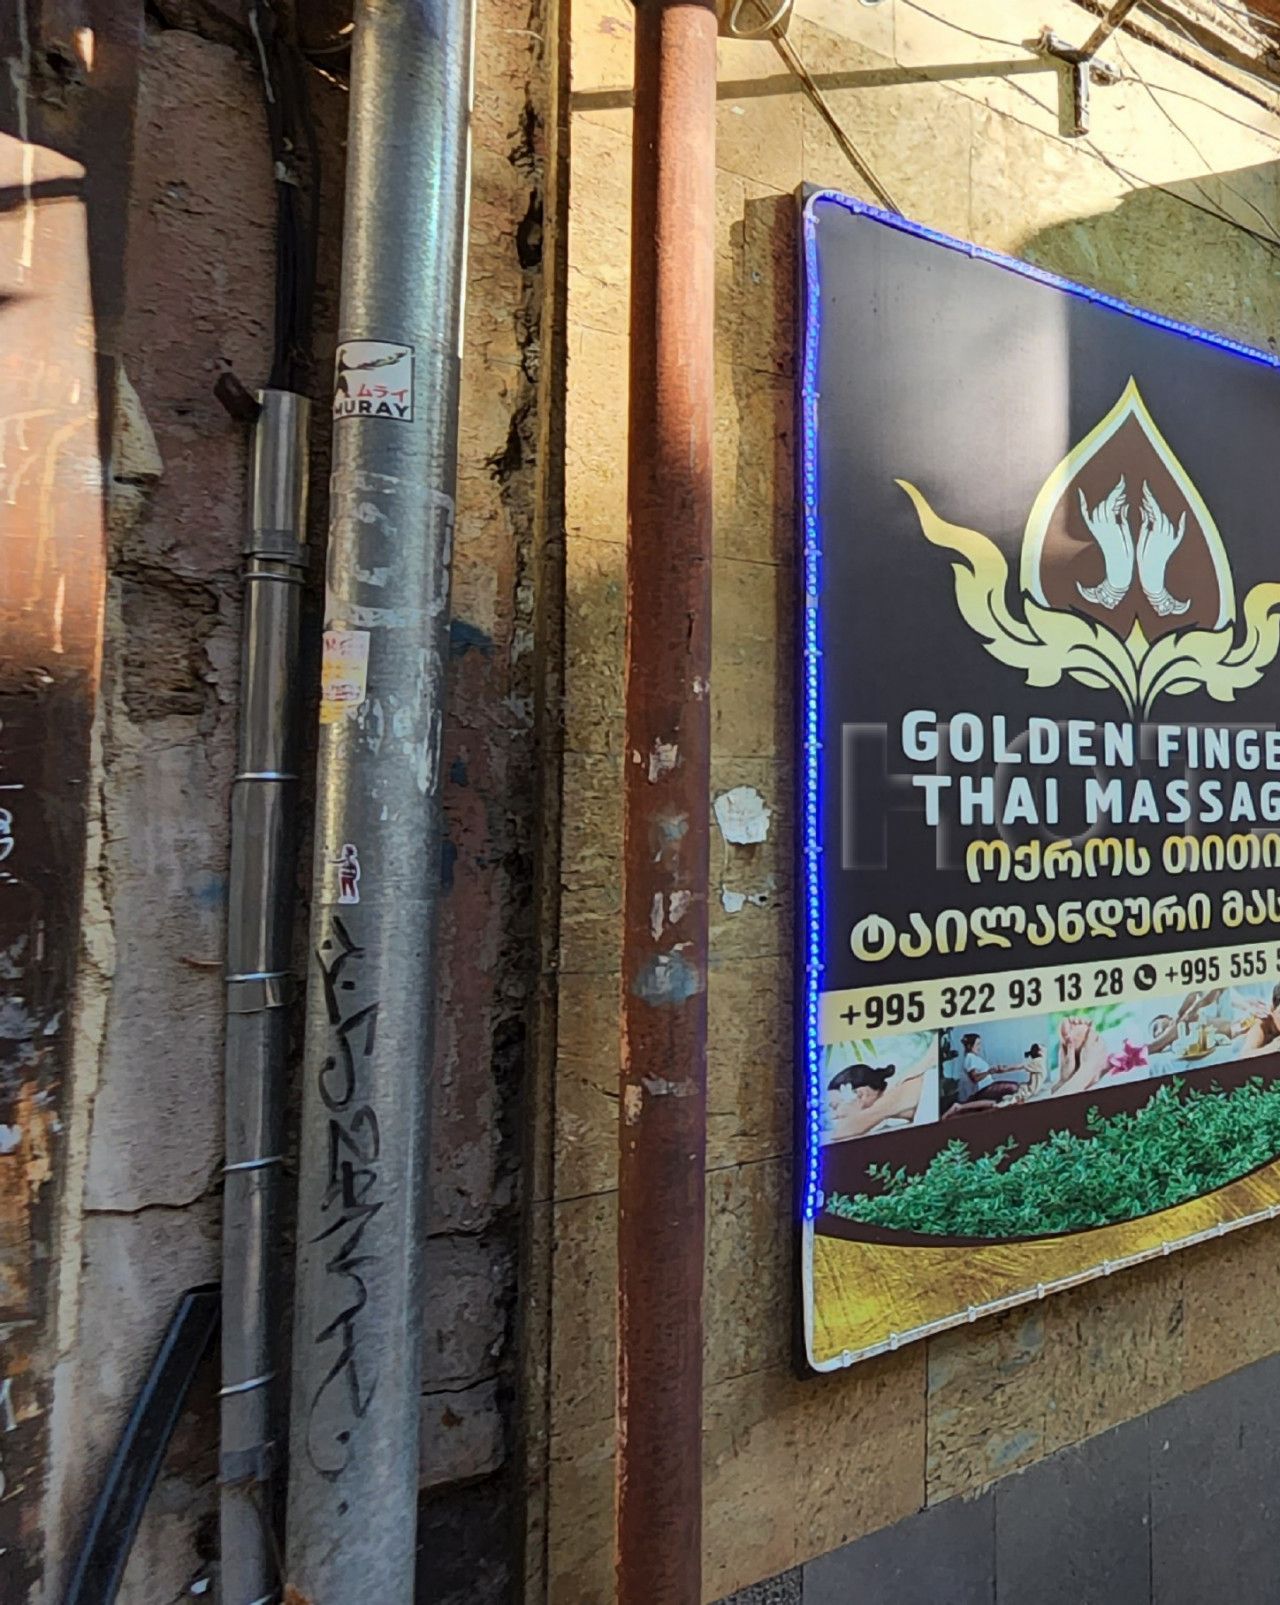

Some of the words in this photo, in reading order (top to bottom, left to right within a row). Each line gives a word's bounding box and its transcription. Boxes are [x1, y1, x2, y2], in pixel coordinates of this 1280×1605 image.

[901, 709, 1136, 768] GOLDEN
[912, 774, 1059, 826] THAI
[966, 837, 1151, 883] ოქროს
[850, 890, 1210, 962] ტაილანდური
[1165, 955, 1220, 986] +995
[1229, 949, 1267, 978] 555
[840, 991, 926, 1030] +995
[941, 983, 995, 1020] 322
[1009, 977, 1042, 1009] 93
[1054, 972, 1083, 1003] 13
[1093, 968, 1123, 998] 28
